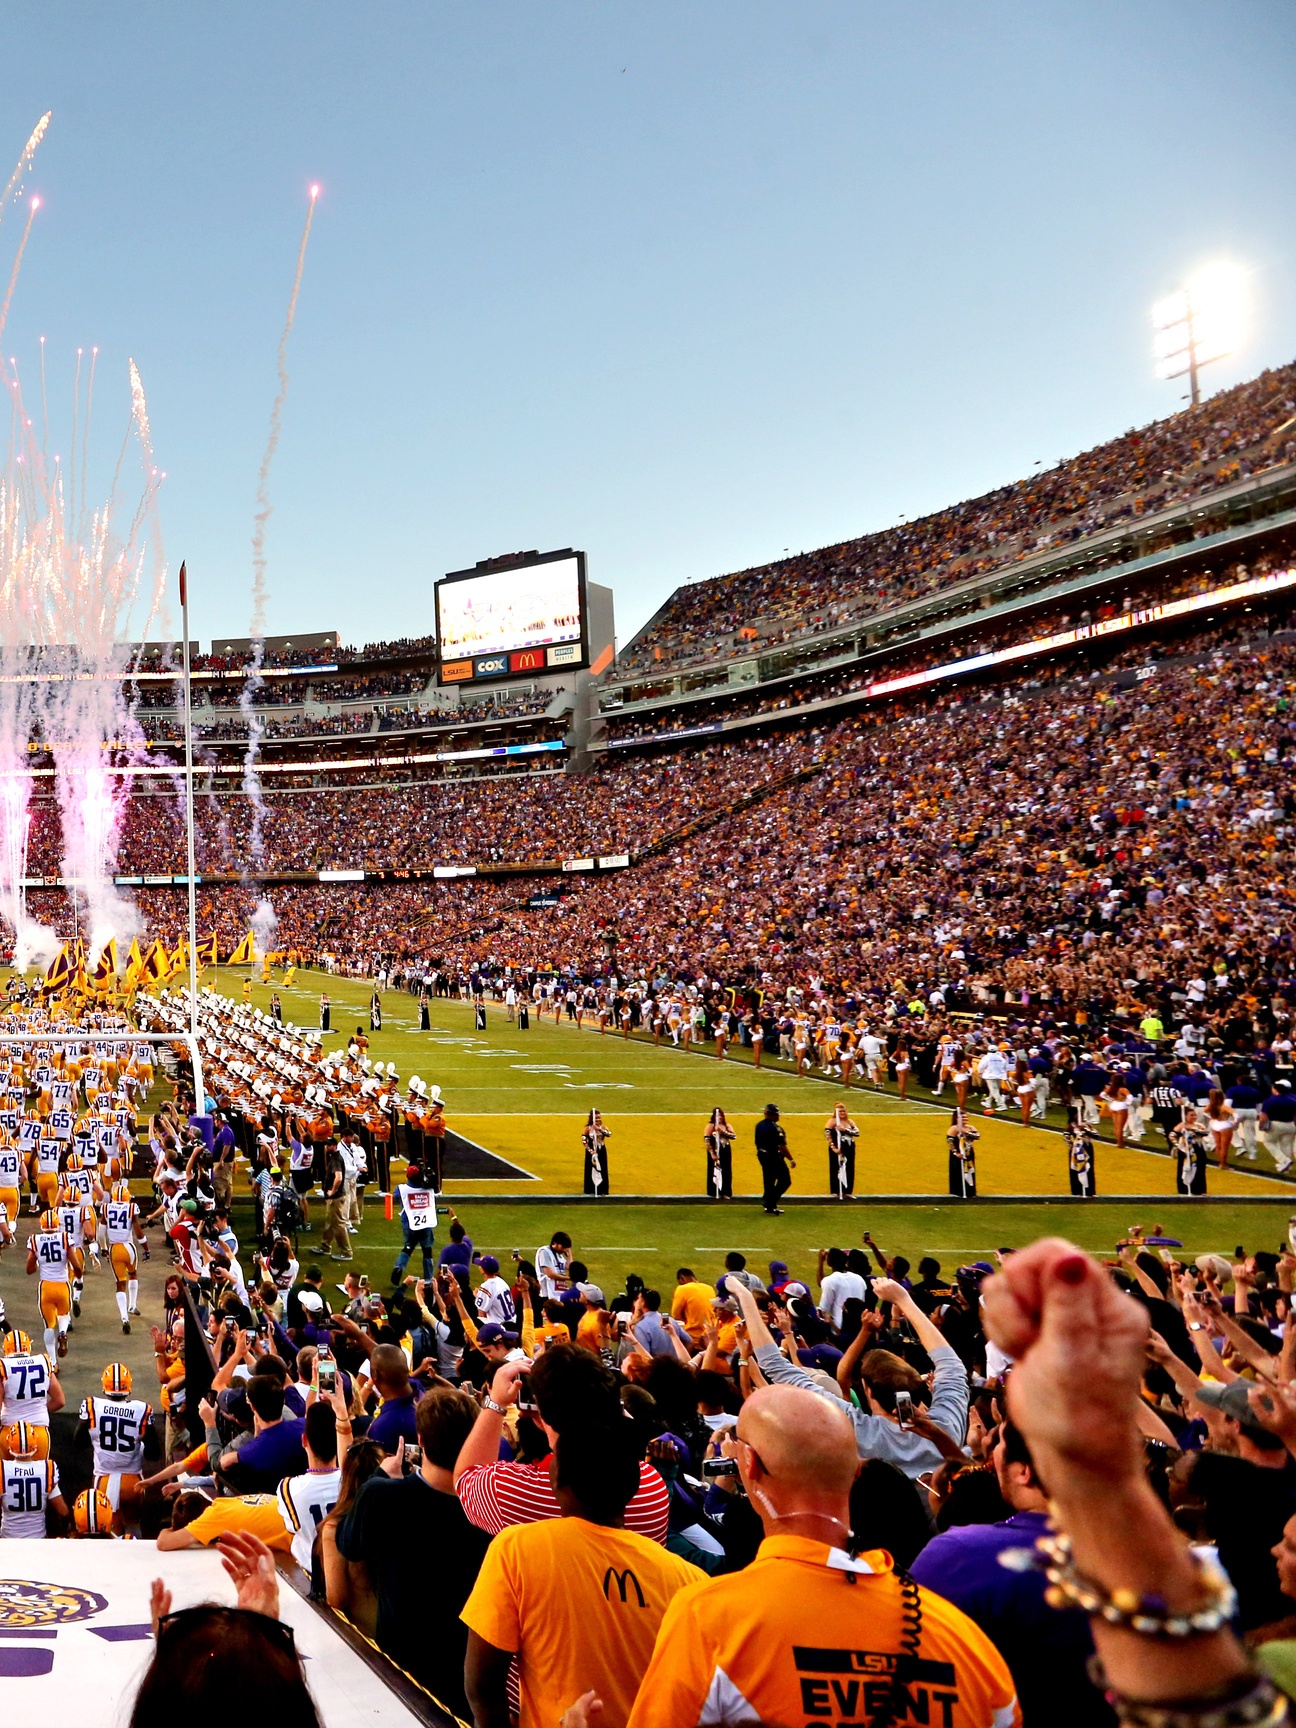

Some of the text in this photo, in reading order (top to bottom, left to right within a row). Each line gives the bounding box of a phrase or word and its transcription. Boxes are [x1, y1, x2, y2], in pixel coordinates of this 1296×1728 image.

[488, 552, 524, 569] LSU
[443, 669, 459, 677] LSU
[477, 659, 505, 673] COX
[829, 1026, 840, 1036] 70
[11, 1046, 22, 1057] 96
[68, 1045, 77, 1055] 71
[96, 1042, 106, 1052] 44
[139, 1047, 149, 1057] 97
[38, 1051, 48, 1060] 45
[86, 1070, 98, 1081] 27
[54, 1085, 68, 1098] 77
[98, 1095, 109, 1108] 83
[0, 1113, 16, 1129] 56
[52, 1113, 70, 1129] 65
[23, 1123, 42, 1140] 78
[101, 1131, 113, 1146] 41
[41, 1144, 58, 1161] 54
[77, 1139, 96, 1158] 75
[0, 1156, 17, 1173] 43
[64, 1215, 74, 1234] 8
[108, 1210, 128, 1230] 24
[413, 1215, 427, 1226] 24
[40, 1240, 62, 1263] 46
[496, 1288, 516, 1321] 18
[10, 1364, 46, 1400] 72
[103, 1405, 135, 1419] GORDON
[99, 1415, 137, 1453] 85
[14, 1467, 35, 1477] PFAU
[7, 1477, 42, 1512] 30
[851, 1653, 897, 1674] LSU
[800, 1677, 960, 1728] EVENT
